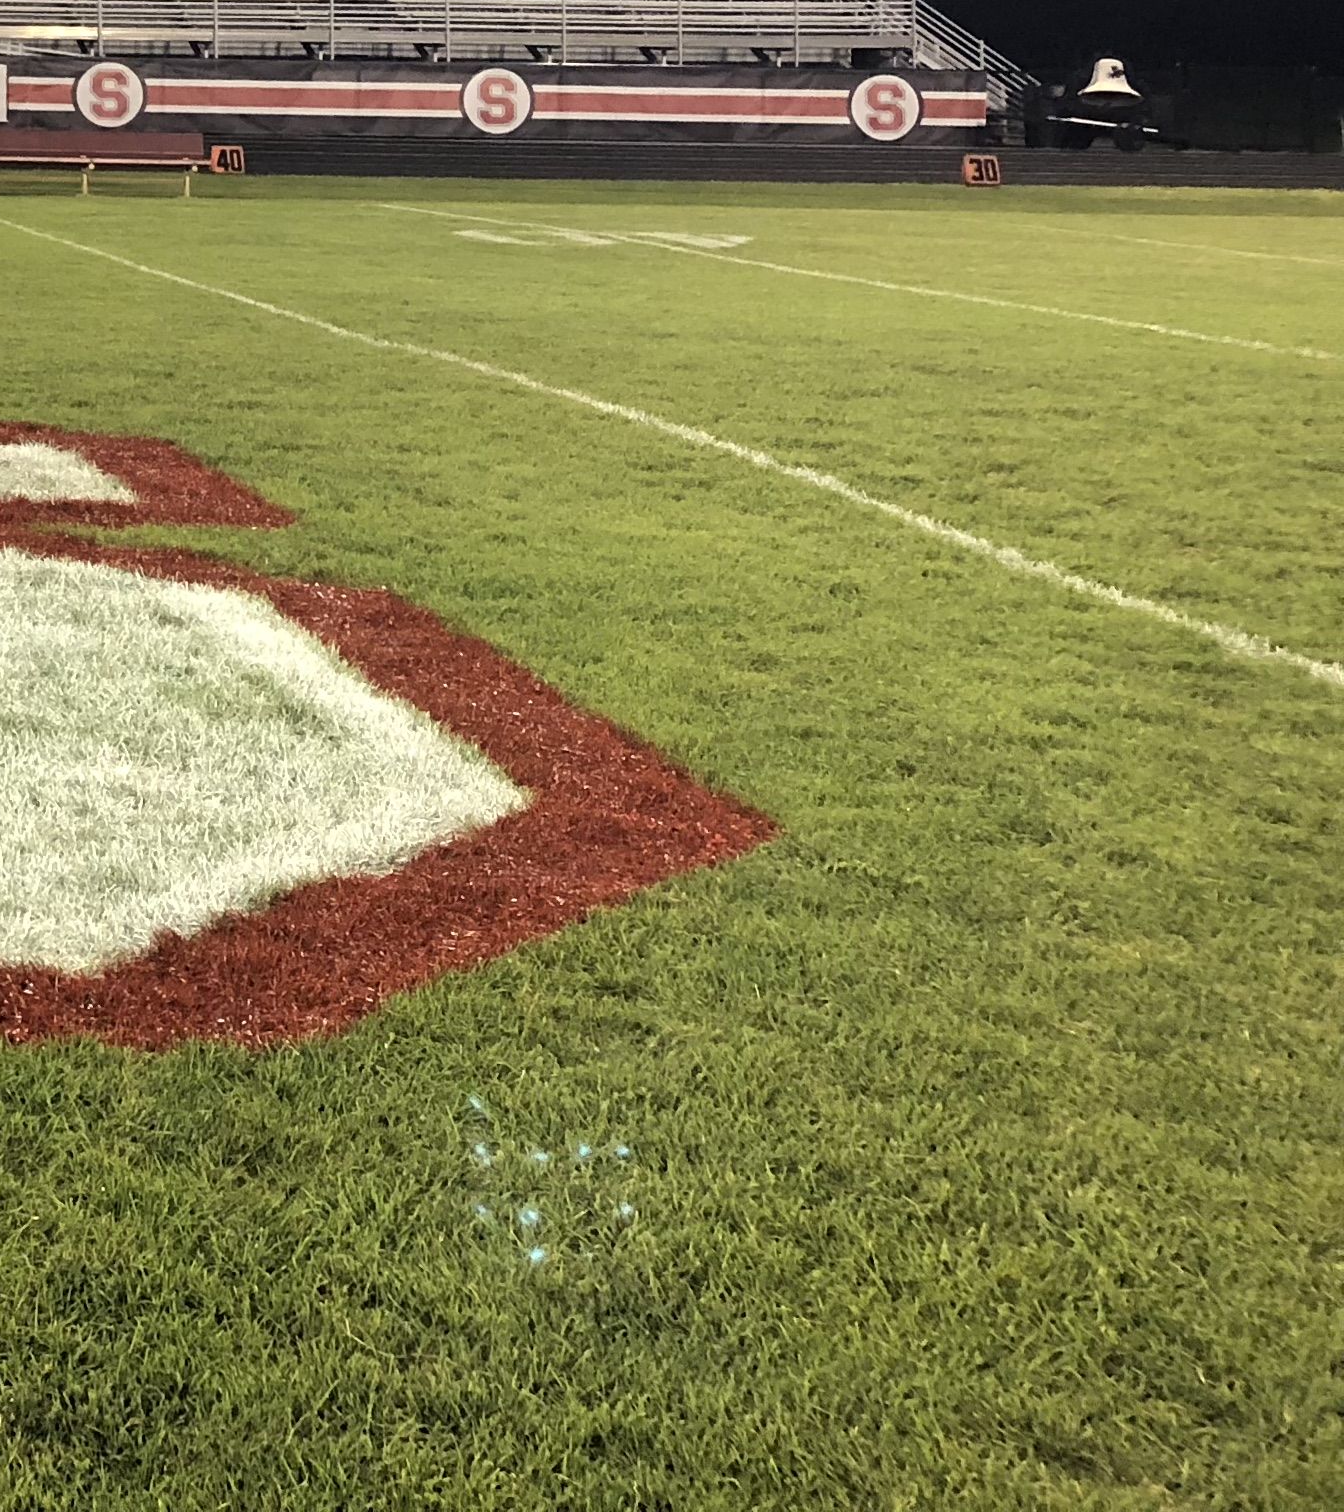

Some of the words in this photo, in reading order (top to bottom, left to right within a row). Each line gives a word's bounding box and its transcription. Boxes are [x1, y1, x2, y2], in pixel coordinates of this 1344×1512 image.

[88, 69, 131, 119] S
[476, 76, 518, 126] S
[864, 83, 907, 131] S
[216, 149, 242, 172] 40
[969, 158, 998, 182] 30
